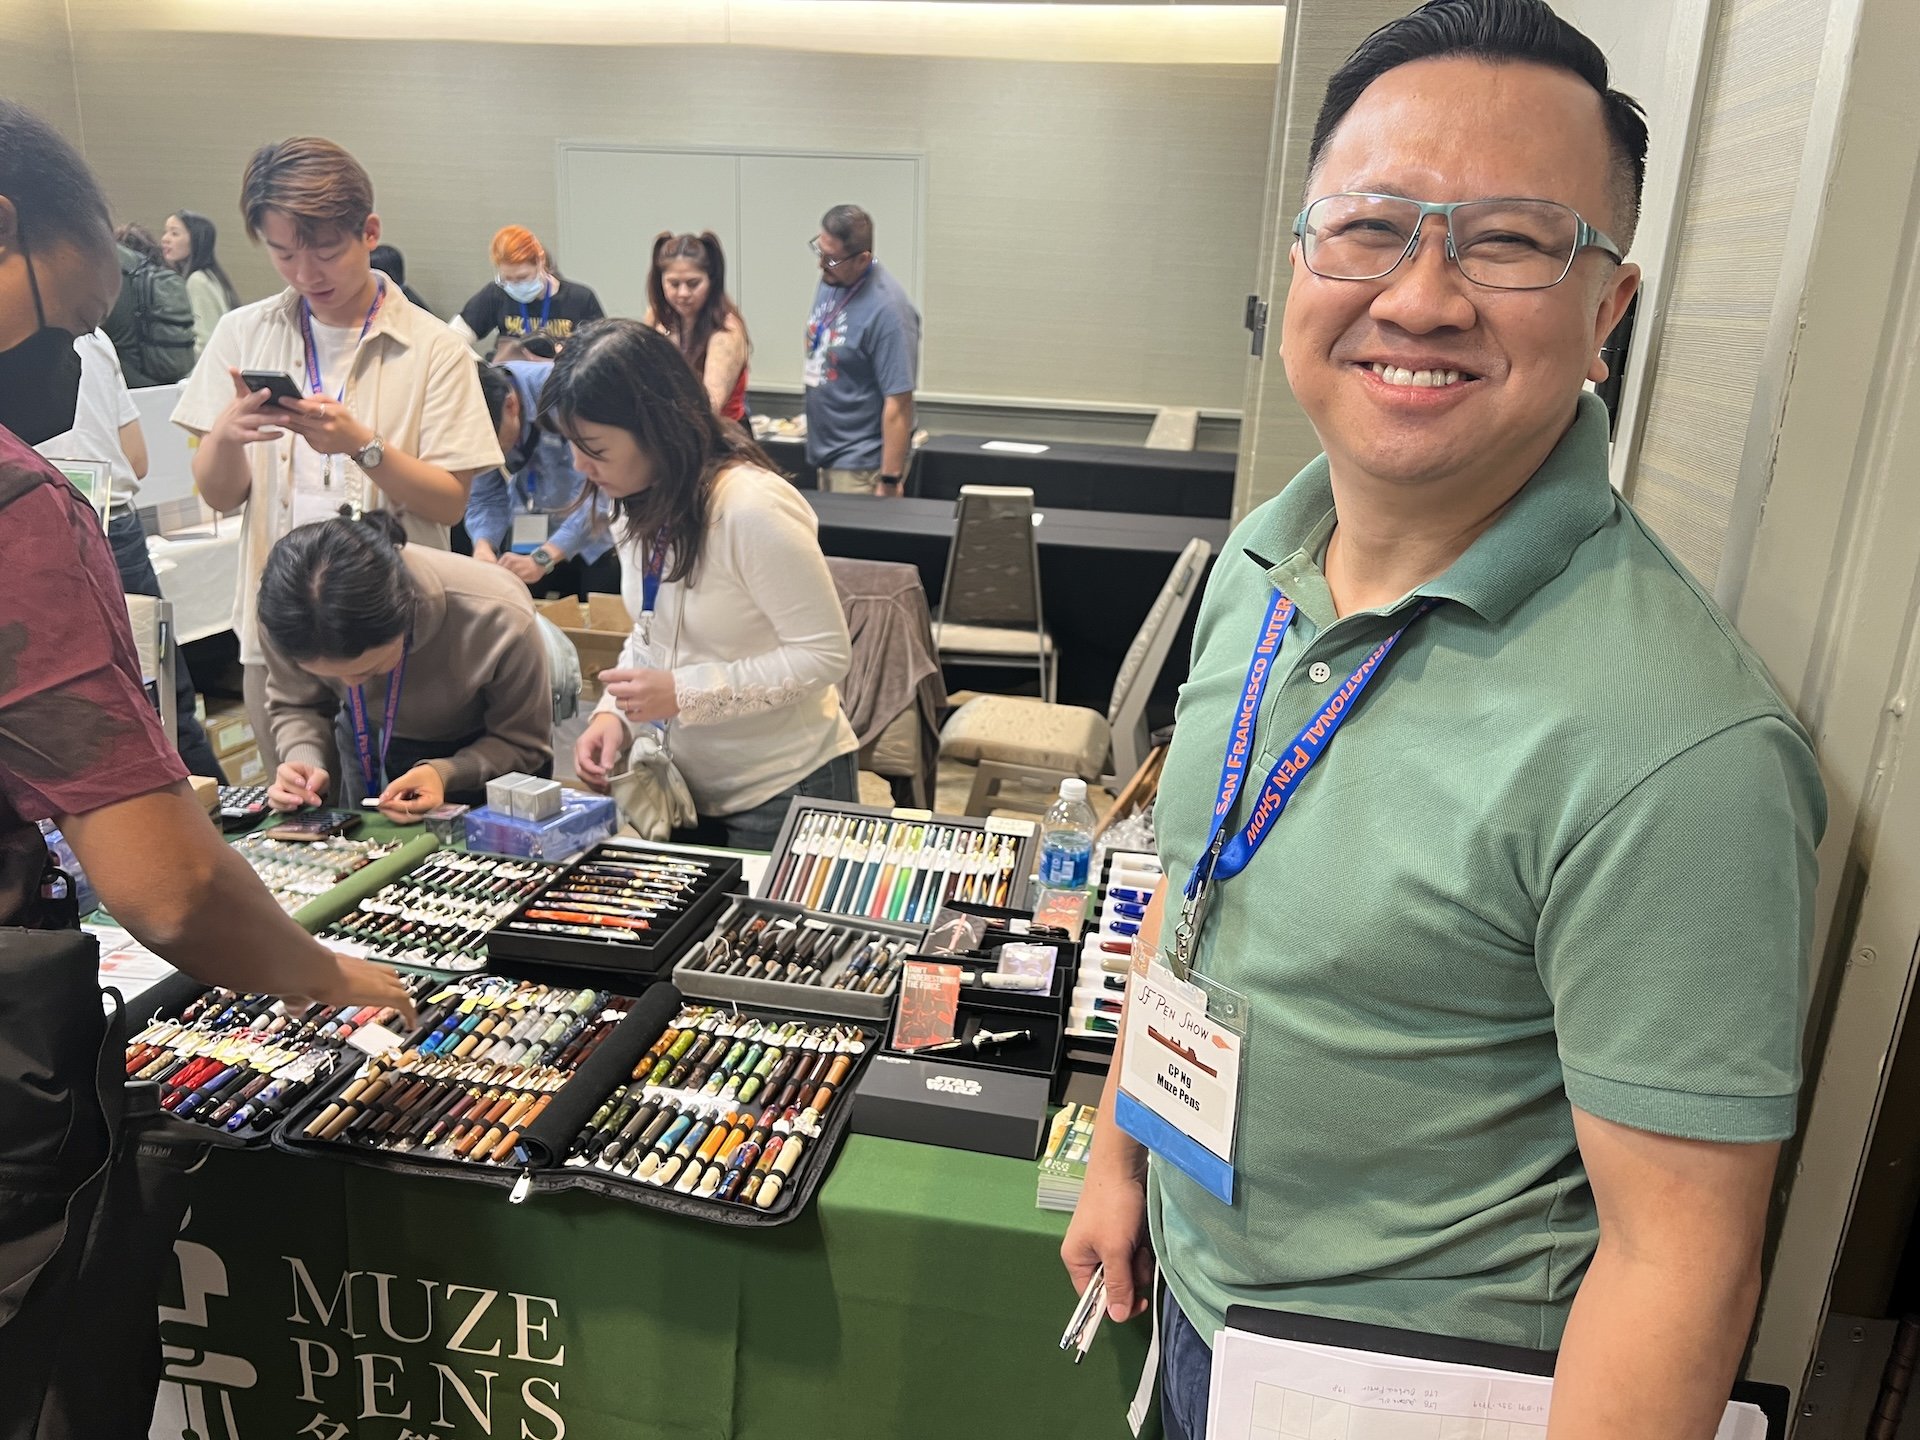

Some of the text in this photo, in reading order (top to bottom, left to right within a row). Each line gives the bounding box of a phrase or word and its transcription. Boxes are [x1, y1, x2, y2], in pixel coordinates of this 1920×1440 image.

[1226, 658, 1267, 768] FRANCISCO
[1272, 745, 1310, 785] PEN
[1215, 774, 1238, 815] SAN
[1246, 786, 1282, 846] SHOW
[1138, 985, 1209, 1040] SF PEN SHOW
[1156, 1073, 1201, 1112] Muze Pens
[1168, 1063, 1192, 1089] CP Ng
[281, 1255, 564, 1367] MUZE
[290, 1337, 566, 1440] PENS
